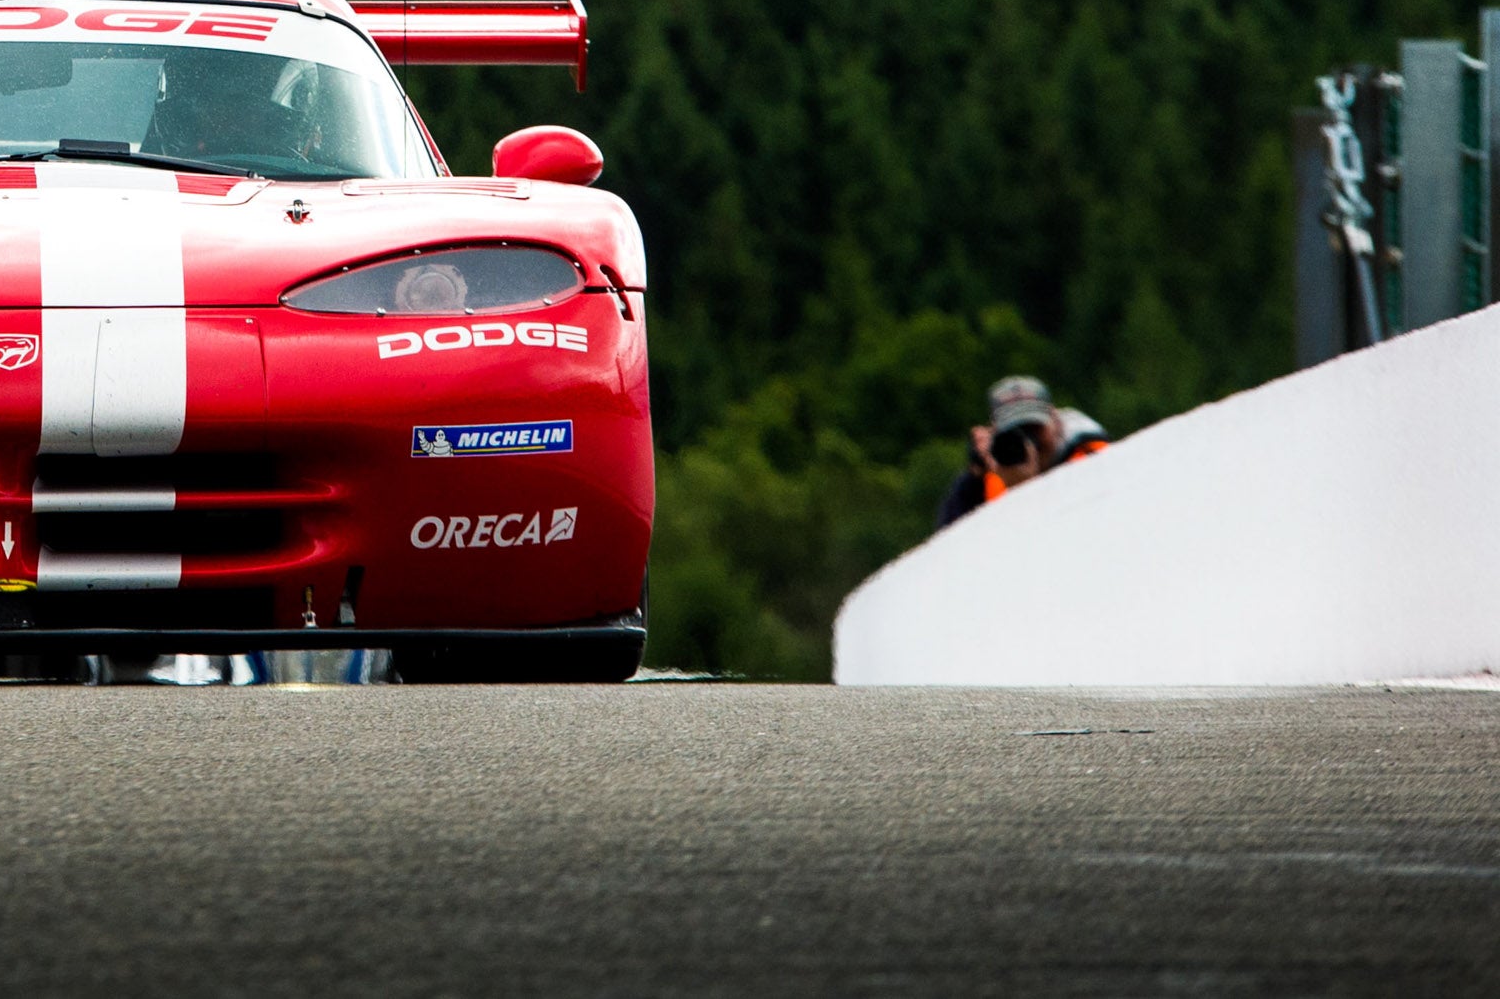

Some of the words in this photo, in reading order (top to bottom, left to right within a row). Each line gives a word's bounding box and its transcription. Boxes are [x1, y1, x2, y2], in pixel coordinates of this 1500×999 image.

[376, 322, 588, 359] DODGE
[457, 427, 566, 447] MICHELIN
[410, 512, 541, 549] ORECA
